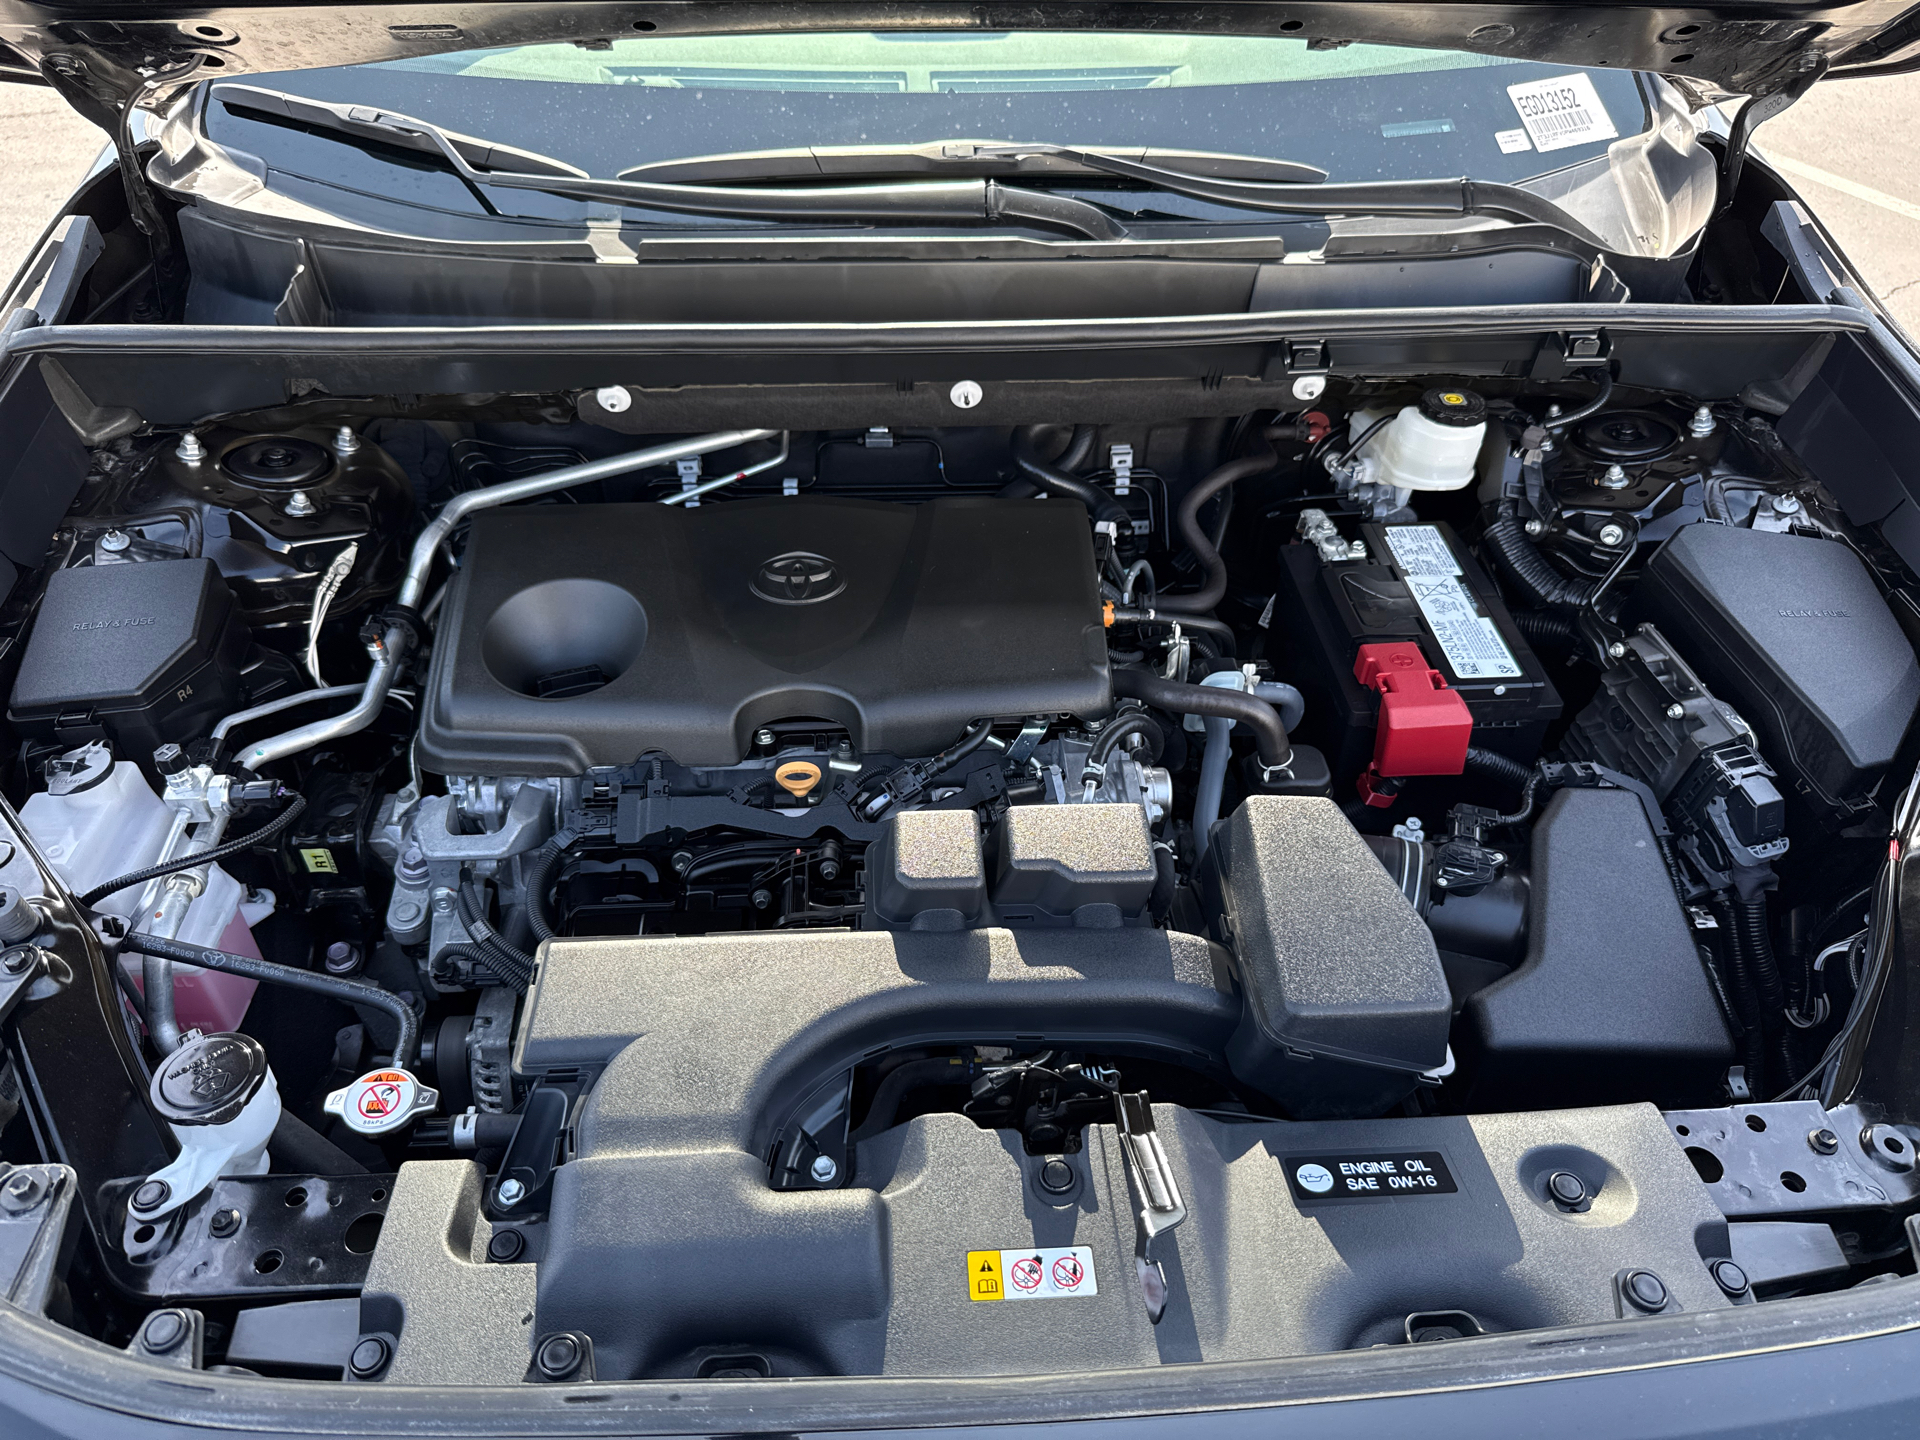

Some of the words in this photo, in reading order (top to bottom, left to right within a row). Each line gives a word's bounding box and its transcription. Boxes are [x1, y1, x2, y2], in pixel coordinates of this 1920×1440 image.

[1516, 87, 1581, 117] EGD13152
[1778, 610, 1811, 618] RELAY
[1813, 610, 1821, 618] &
[1821, 609, 1851, 618] FUSE
[72, 620, 112, 631] RELAY
[112, 619, 121, 628] &
[123, 616, 156, 627] FUSE
[1431, 619, 1465, 661] 375LN2-MF
[1498, 664, 1514, 674] SP
[176, 684, 194, 702] R4
[1795, 778, 1811, 795] L7
[312, 855, 328, 868] R1
[142, 941, 195, 959] 16283-F0060
[230, 959, 285, 977] 16283-F0060
[361, 988, 406, 1013] 16283-F0060
[1338, 1161, 1397, 1175] ENGINE
[1404, 1159, 1433, 1173] OIL
[1345, 1177, 1380, 1191] SAE
[1388, 1174, 1438, 1189] 0W-16
